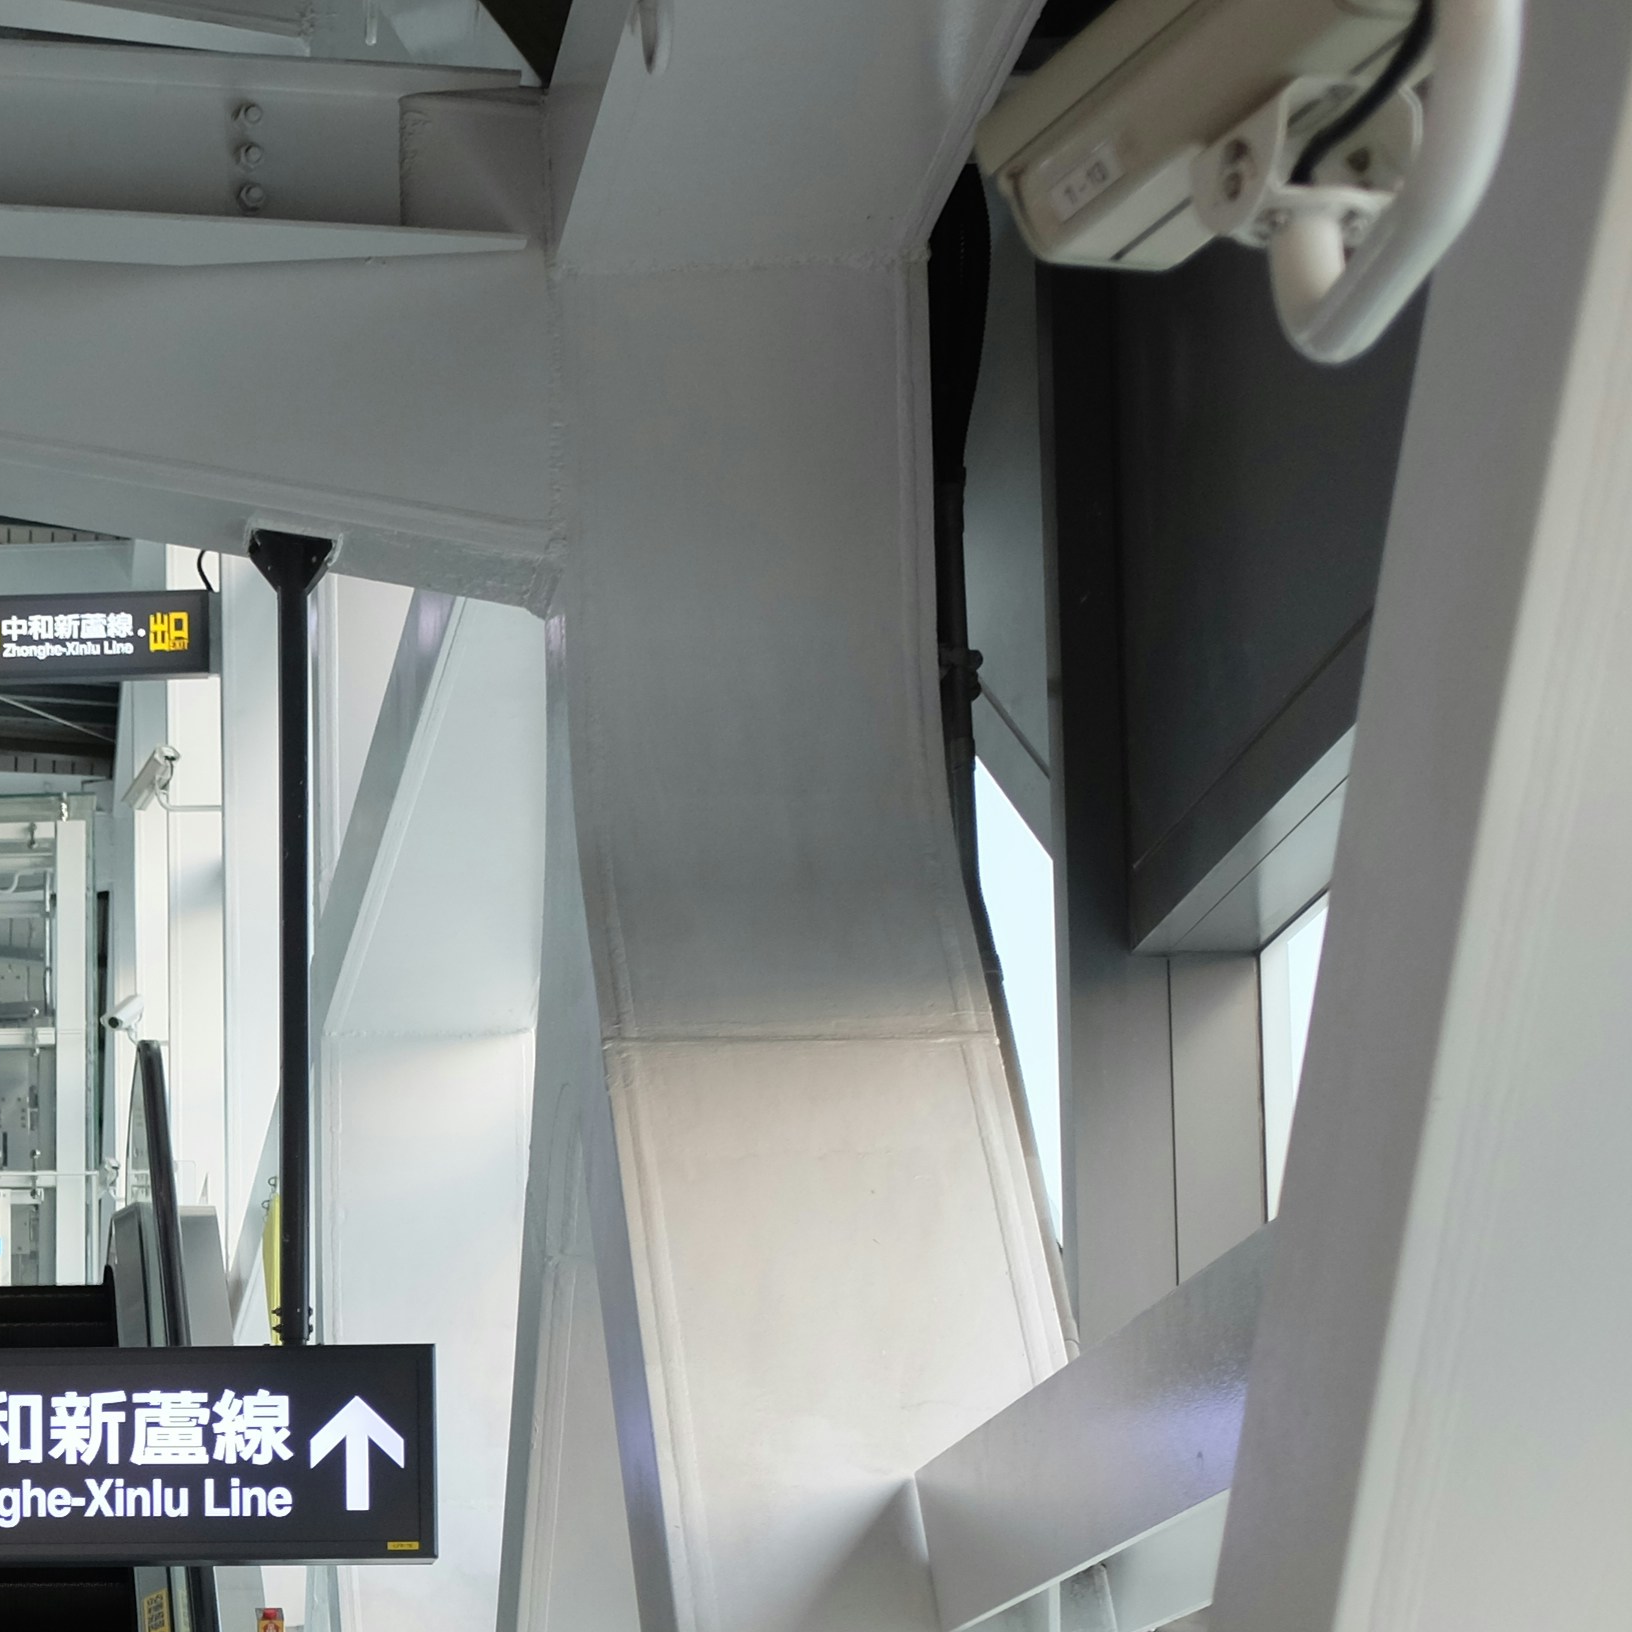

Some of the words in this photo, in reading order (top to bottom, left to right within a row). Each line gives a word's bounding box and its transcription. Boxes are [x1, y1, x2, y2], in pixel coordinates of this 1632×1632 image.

[2, 612, 134, 641] 中和新蘆線
[149, 611, 188, 652] 出口
[2, 641, 100, 660] Zhonghe-Xinlu
[103, 640, 134, 655] Line
[205, 1478, 292, 1518] Line
